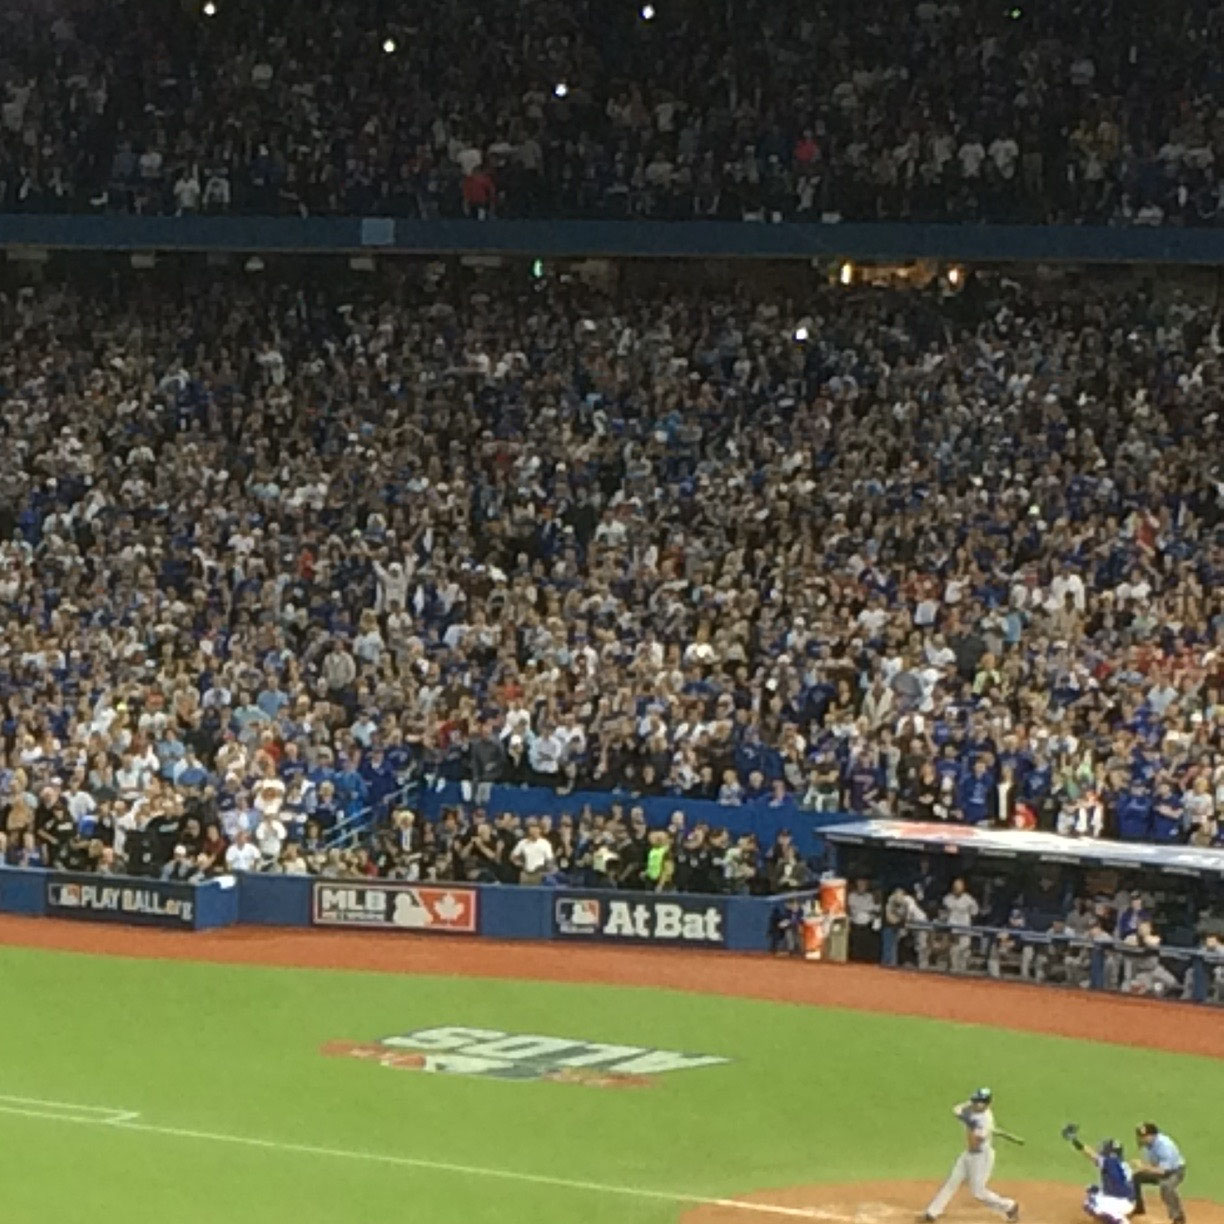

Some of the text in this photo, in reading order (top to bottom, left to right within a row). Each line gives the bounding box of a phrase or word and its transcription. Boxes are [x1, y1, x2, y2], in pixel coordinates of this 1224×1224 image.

[322, 887, 387, 911] MLB
[603, 900, 724, 941] At Bat
